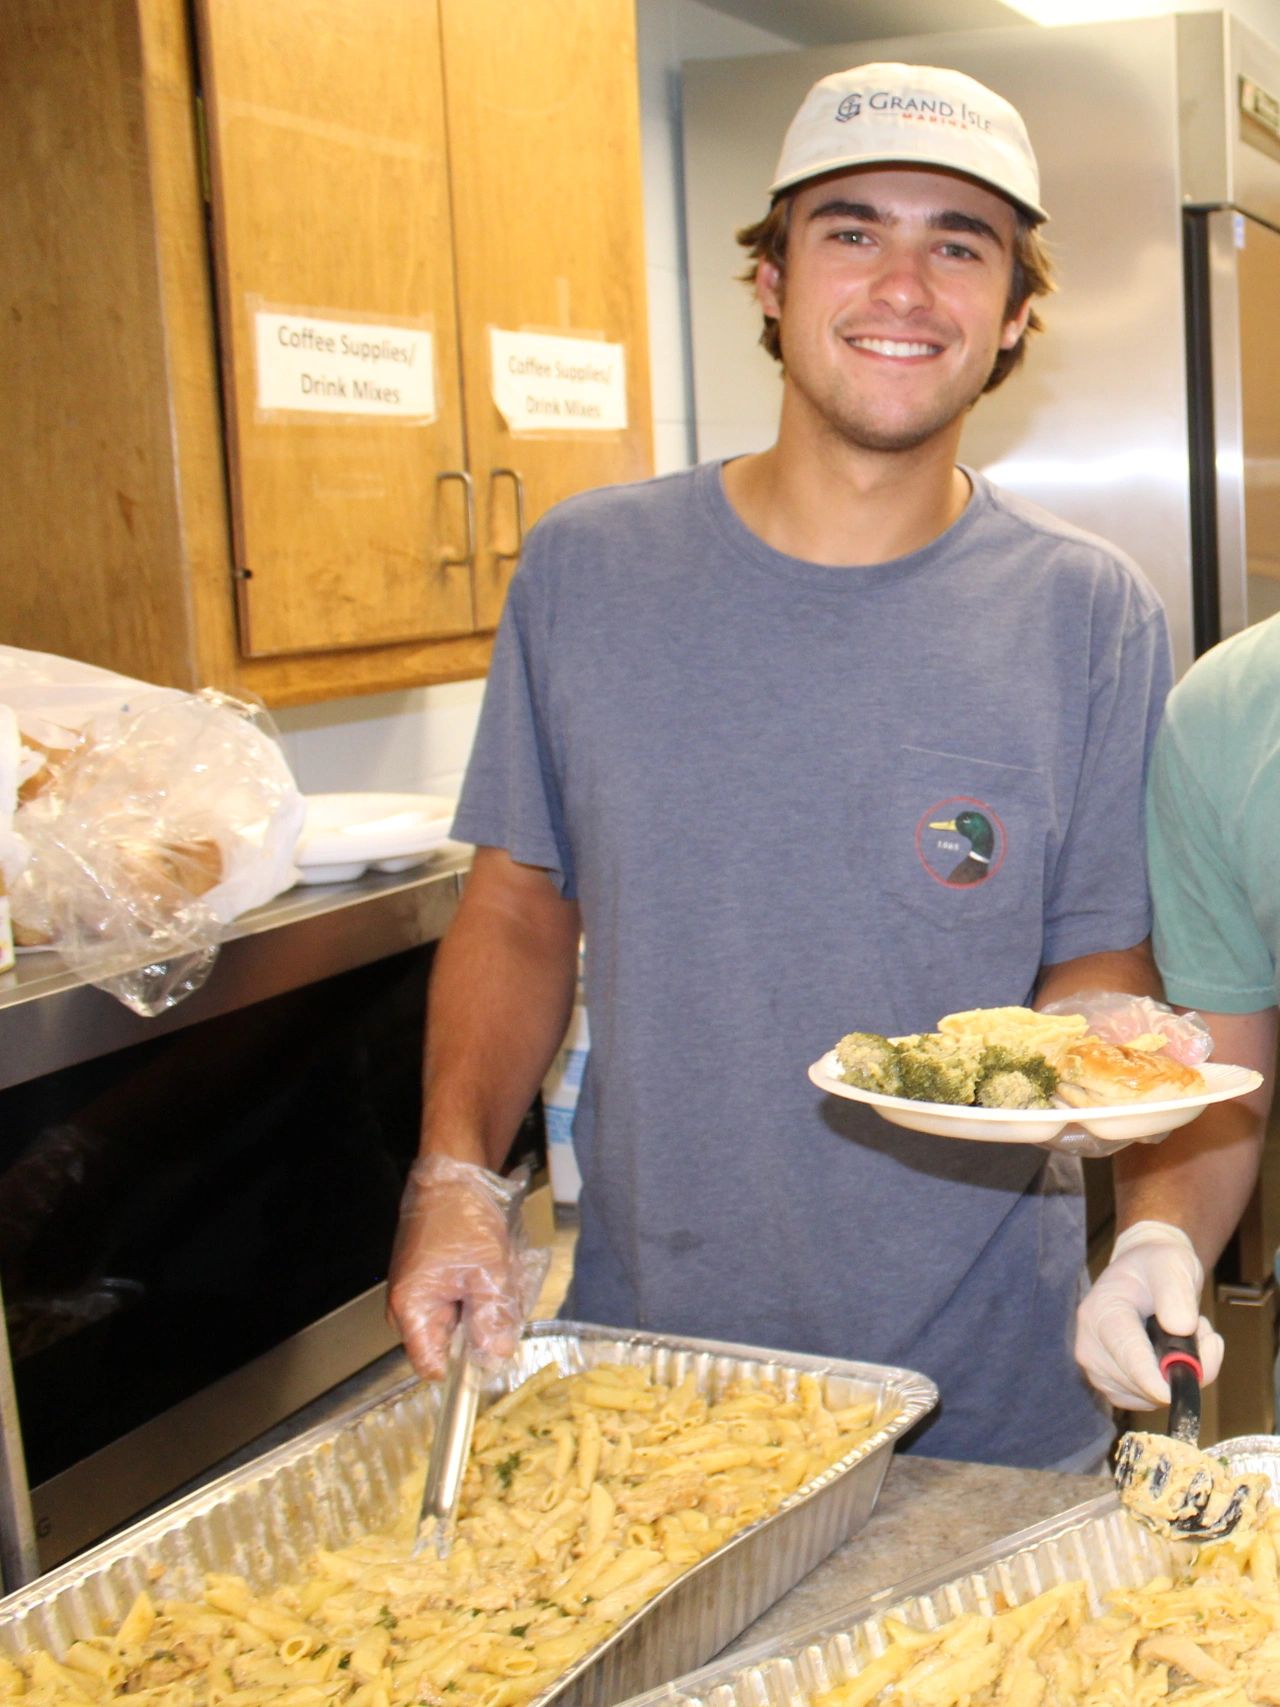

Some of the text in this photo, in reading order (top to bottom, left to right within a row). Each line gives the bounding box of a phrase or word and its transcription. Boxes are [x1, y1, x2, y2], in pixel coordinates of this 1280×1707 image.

[868, 92, 954, 118] GRAND
[961, 103, 992, 133] ISLE
[277, 325, 416, 367] Coffee Supplies/
[508, 355, 614, 386] Coffee Supplies/
[300, 373, 400, 404] Drink Mixes
[526, 395, 602, 418] Drink Mixes
